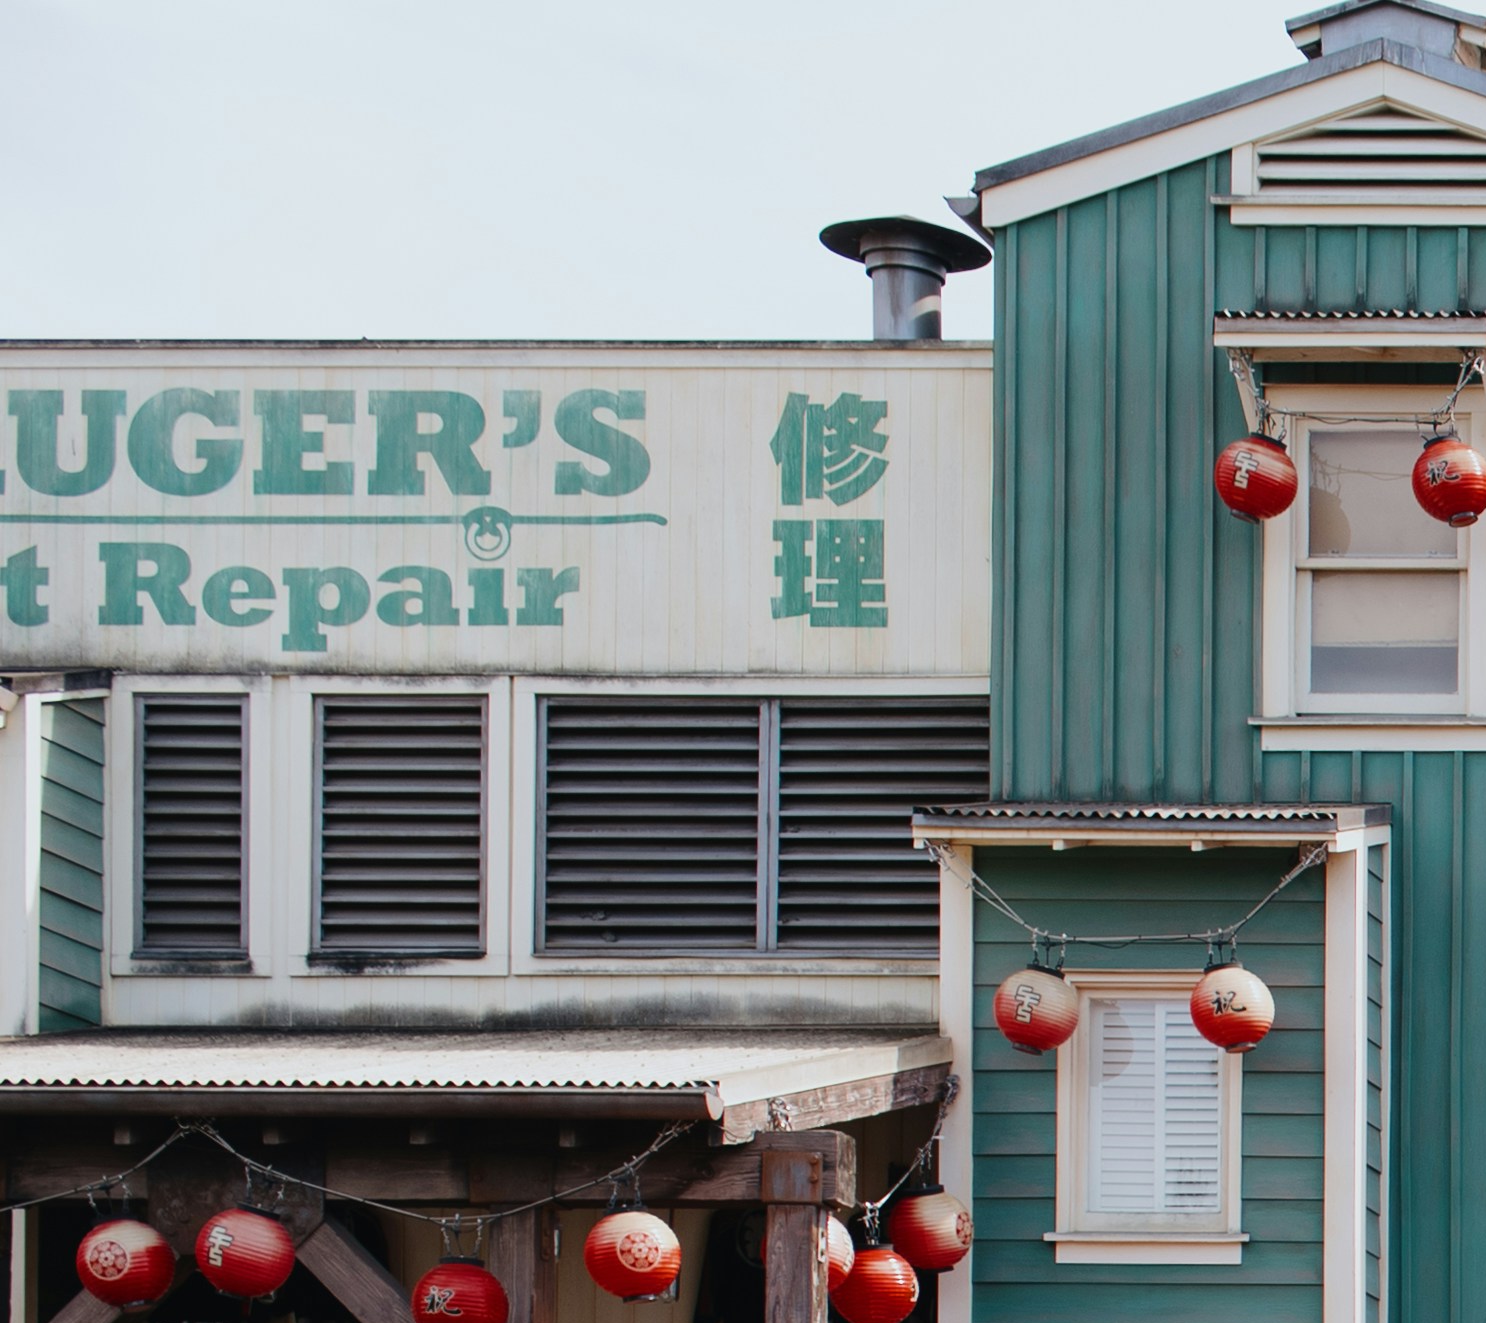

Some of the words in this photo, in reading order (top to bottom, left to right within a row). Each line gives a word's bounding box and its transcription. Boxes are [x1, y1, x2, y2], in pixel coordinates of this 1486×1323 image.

[0, 387, 651, 498] UGER'S
[770, 391, 891, 629] 修理
[98, 541, 581, 653] Repair
